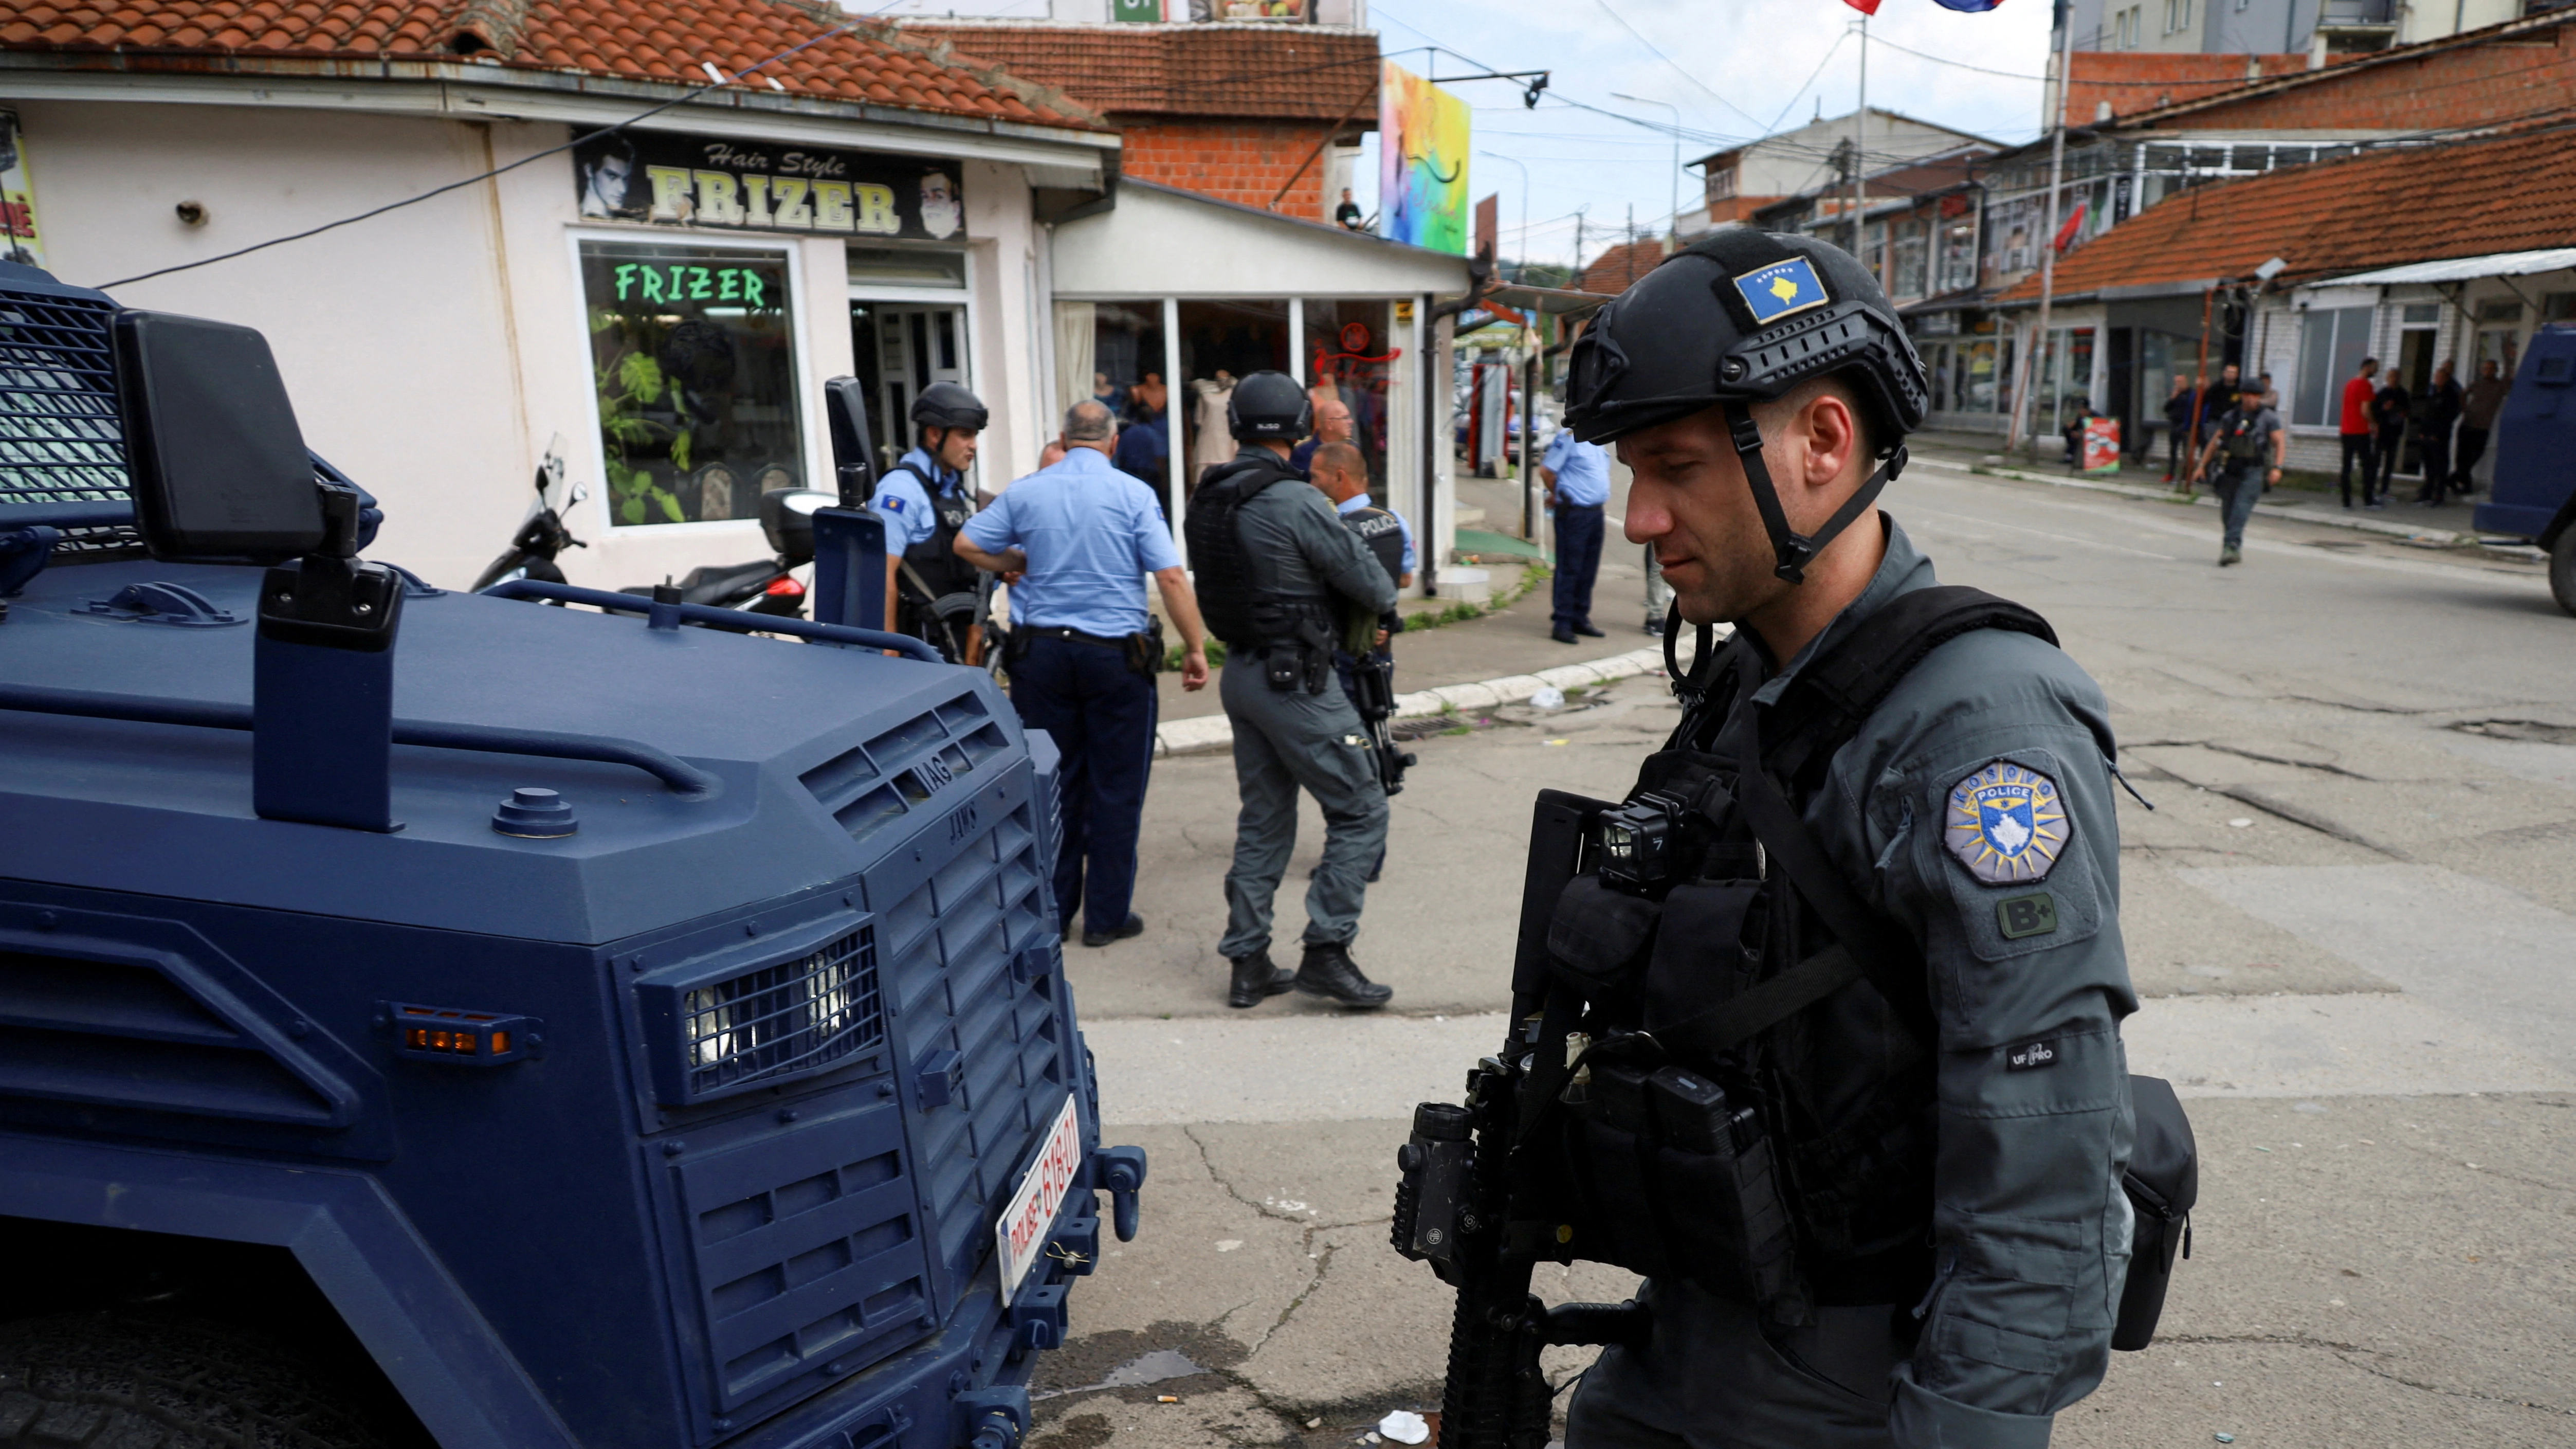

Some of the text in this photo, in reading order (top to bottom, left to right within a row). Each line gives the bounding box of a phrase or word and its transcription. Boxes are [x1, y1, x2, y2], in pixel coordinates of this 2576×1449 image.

[704, 143, 847, 178] Hair Style
[646, 165, 901, 235] FRIZER
[614, 263, 765, 307] FRIZER
[914, 756, 953, 792] IAG
[1954, 766, 2052, 802] KOSOVO
[1978, 786, 2030, 800] POLICE
[1653, 840, 1662, 850] 7
[2006, 899, 2051, 933] B+
[2013, 1049, 2053, 1064] UF PRO
[1042, 1108, 1077, 1218] 618-01
